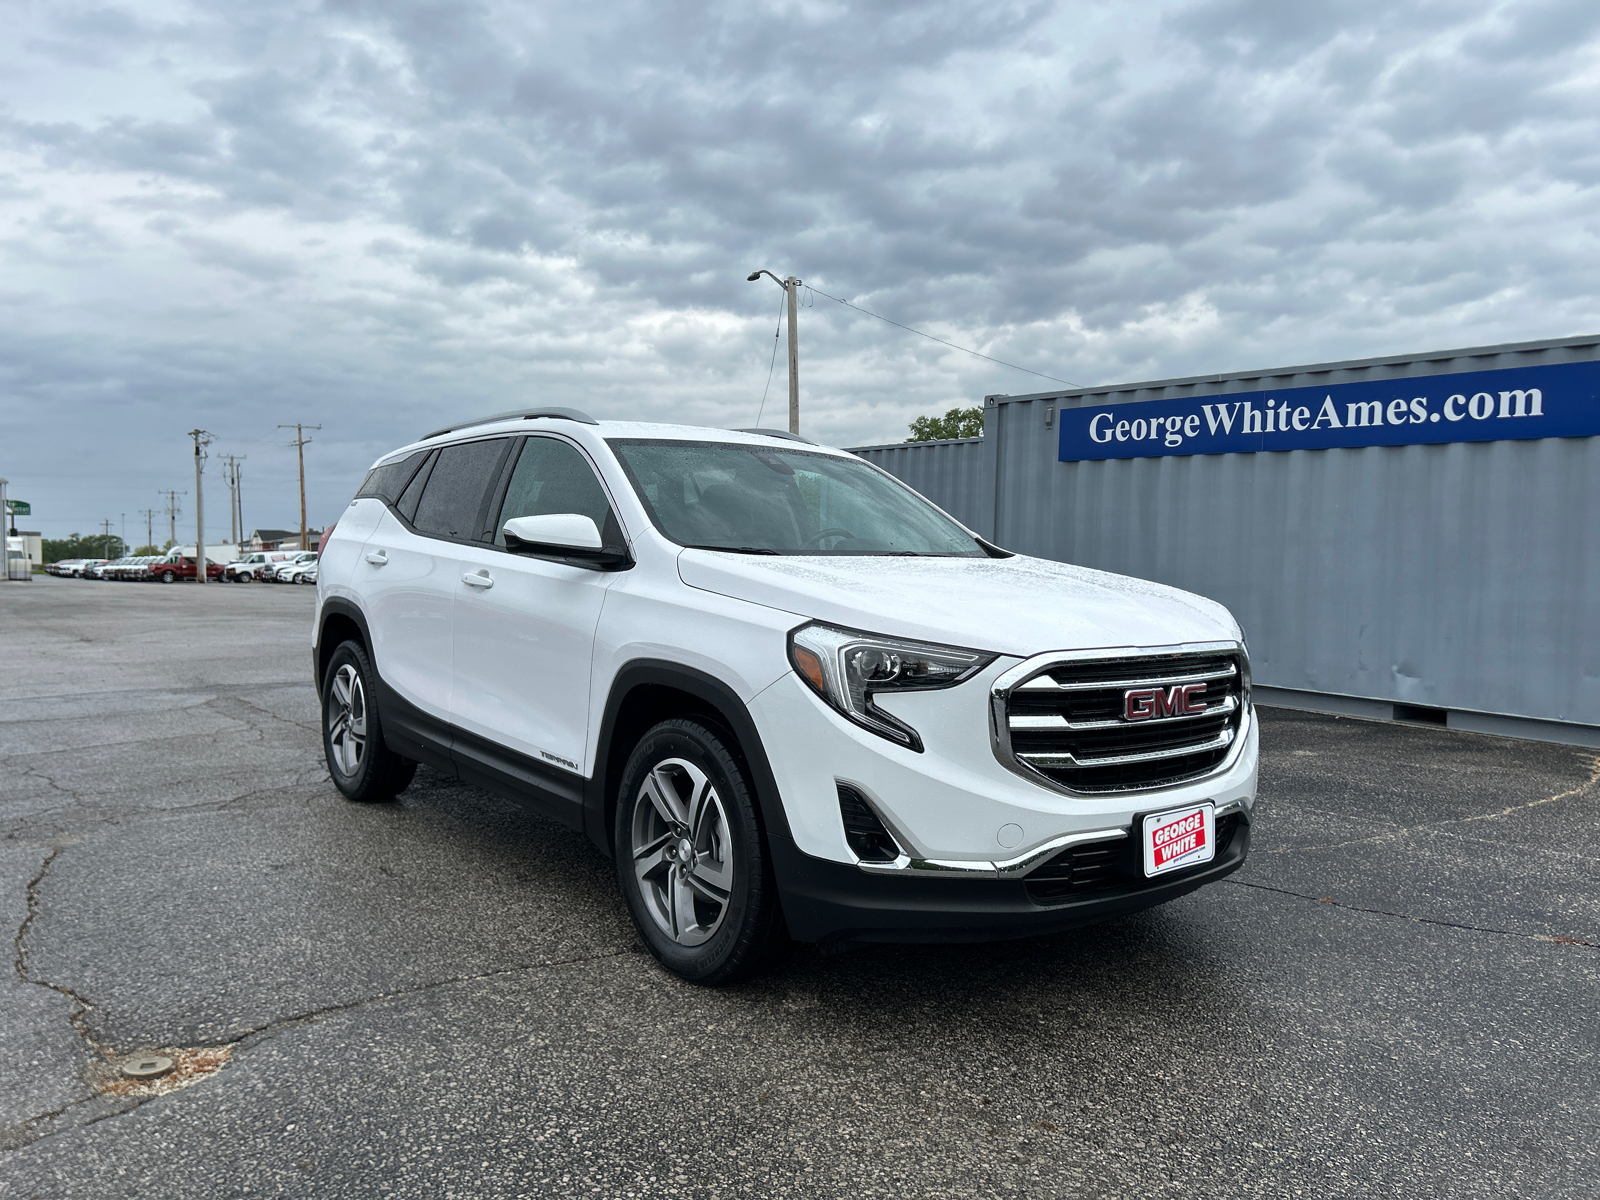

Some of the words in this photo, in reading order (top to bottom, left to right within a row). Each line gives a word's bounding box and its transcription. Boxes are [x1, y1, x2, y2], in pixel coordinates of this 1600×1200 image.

[1088, 387, 1545, 448] GeorgeWhiteAmes.com
[1124, 682, 1208, 720] GMC
[539, 750, 579, 771] TERRAIN
[1154, 813, 1201, 845] GEORGE
[1160, 833, 1197, 862] WHITE
